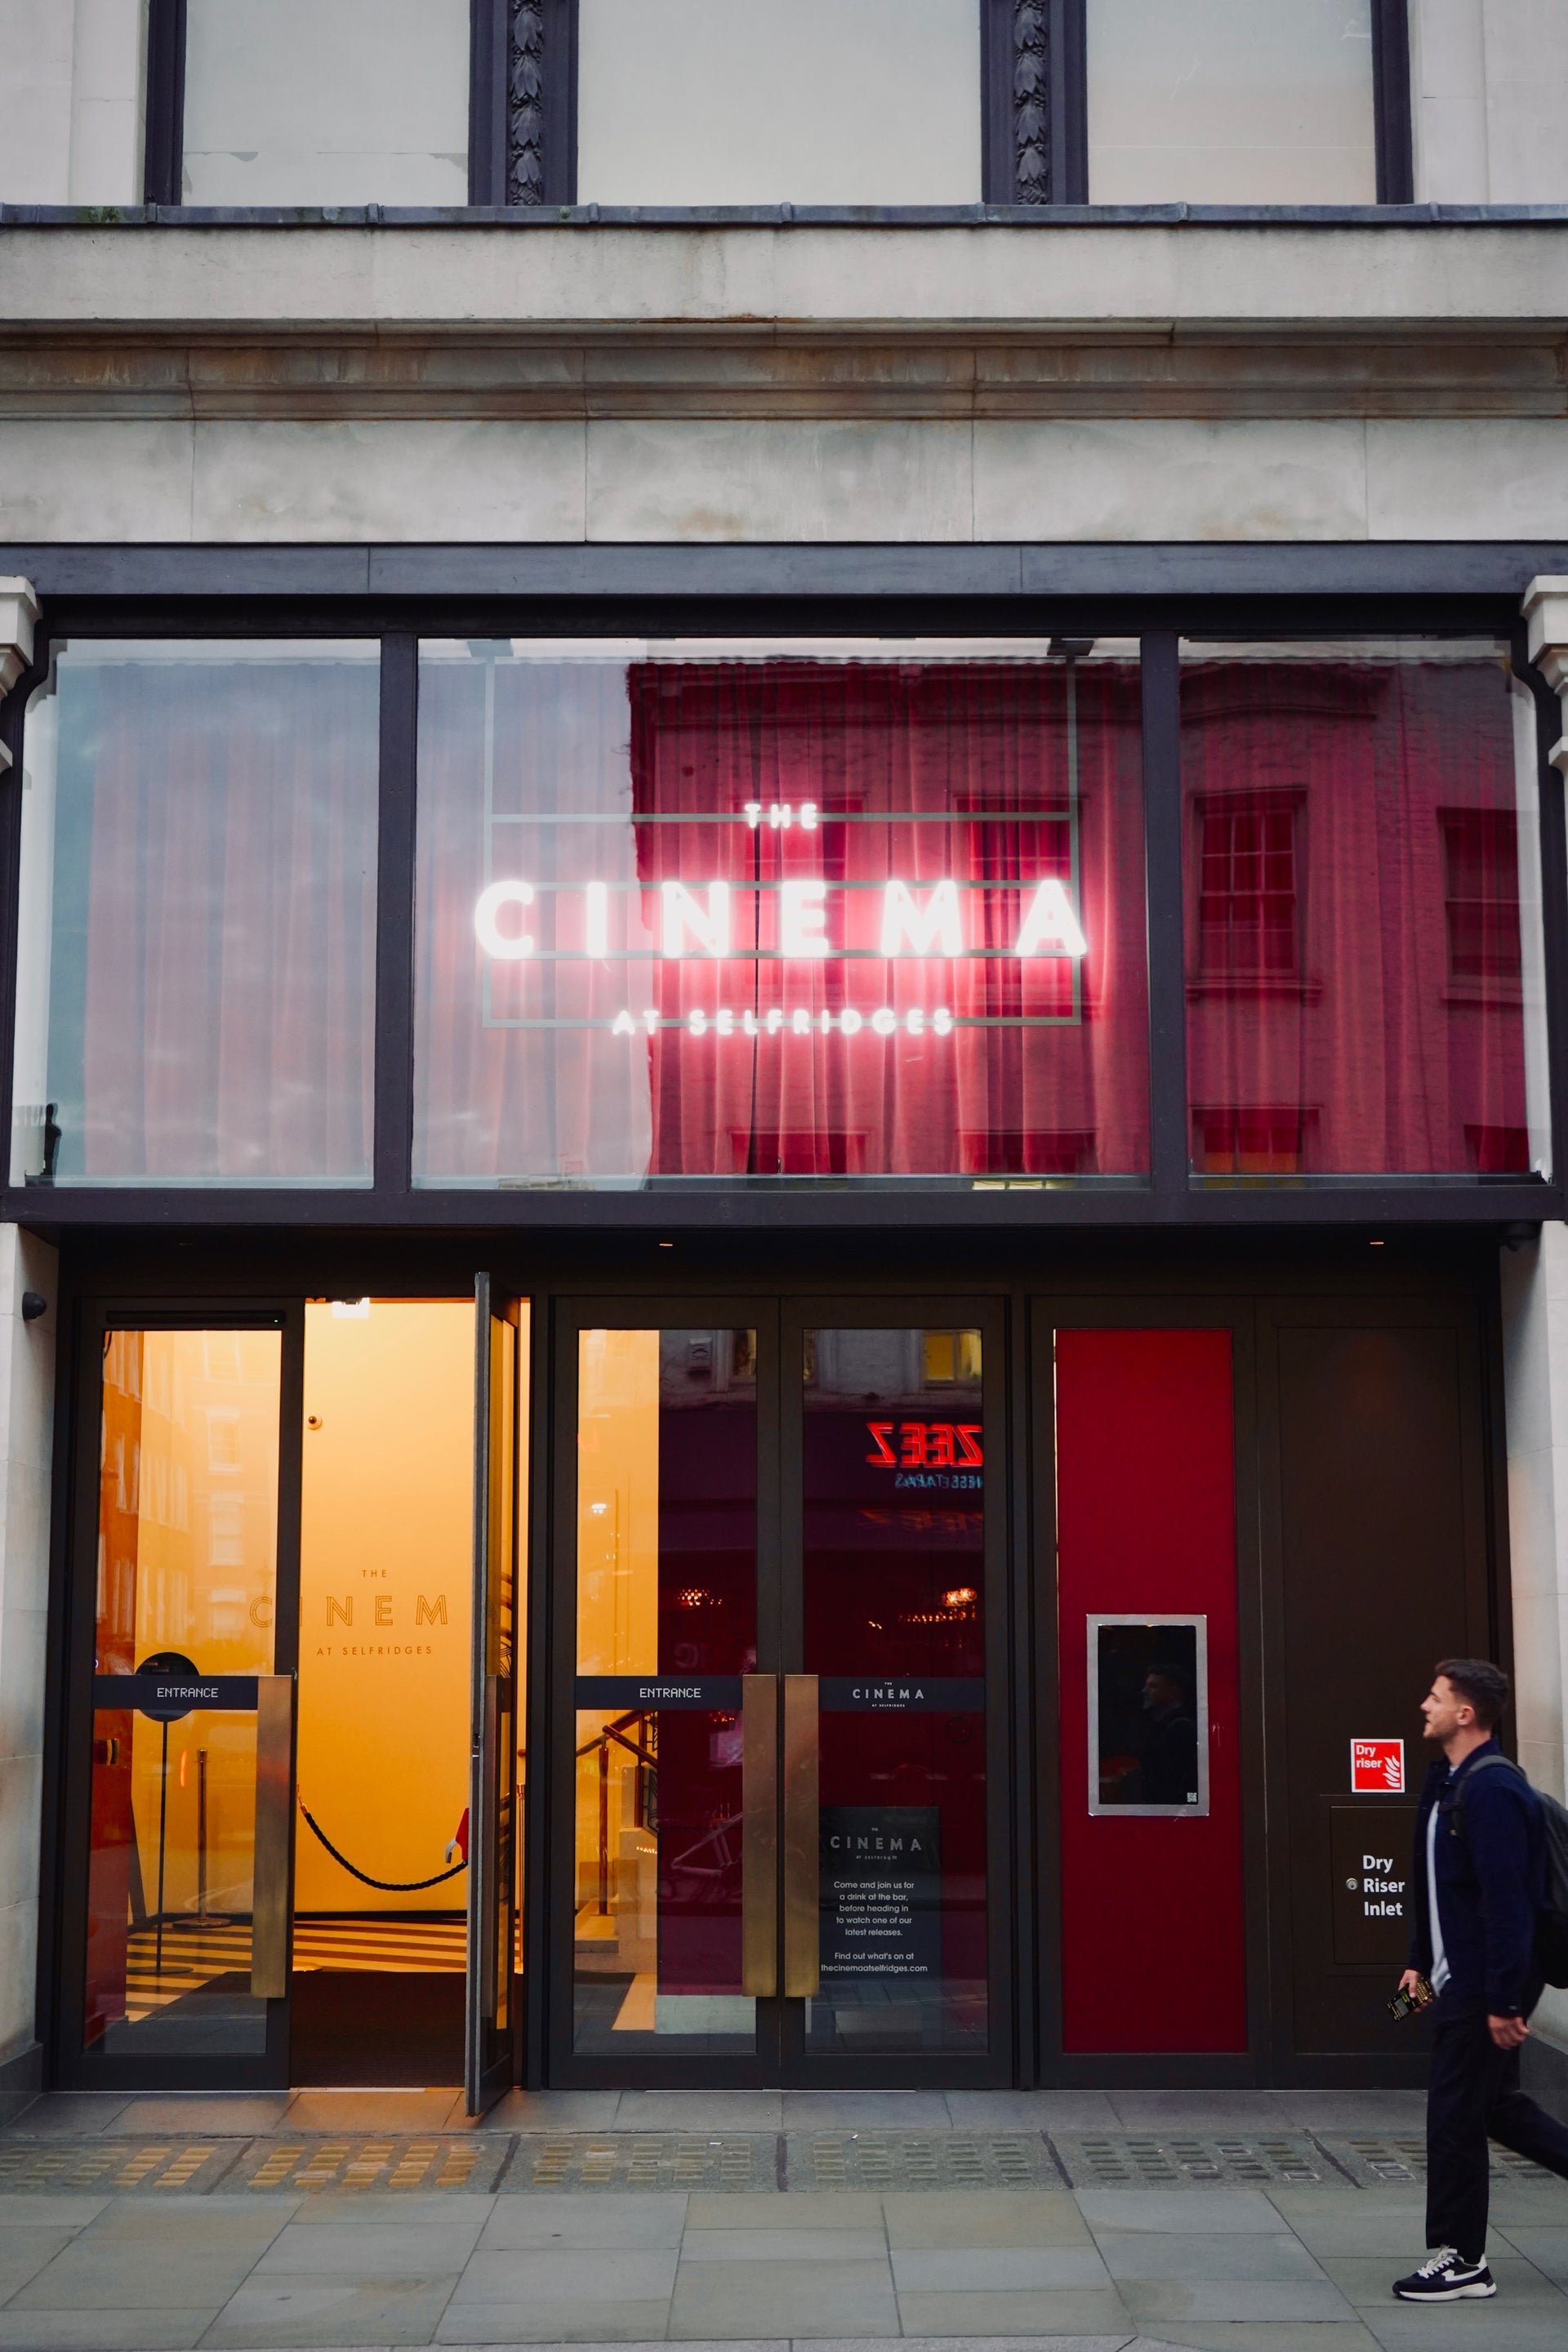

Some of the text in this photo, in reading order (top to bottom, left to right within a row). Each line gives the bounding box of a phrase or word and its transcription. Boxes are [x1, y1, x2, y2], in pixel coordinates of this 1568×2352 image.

[745, 804, 817, 829] THE
[473, 880, 1088, 959] CINEMA
[612, 1009, 953, 1036] AT SELFRIDGES
[362, 1570, 387, 1578] THE
[317, 1646, 432, 1655] AT SELFRIDGES
[157, 1687, 219, 1698] ENTRANCE
[639, 1688, 702, 1698] ENTRANCE
[853, 1689, 924, 1699] CINEMA
[1356, 1745, 1376, 1757] Dry
[1356, 1758, 1382, 1768] riser
[830, 1836, 922, 1851] CINEMA
[1363, 1855, 1393, 1873] Dry
[877, 1881, 891, 1889] join
[1363, 1878, 1405, 1892] Riser
[893, 1893, 908, 1901] bar,
[867, 1904, 899, 1913] heading
[1364, 1901, 1403, 1916] Inlet
[821, 1964, 928, 1973] thecinemaatselfridges.com
